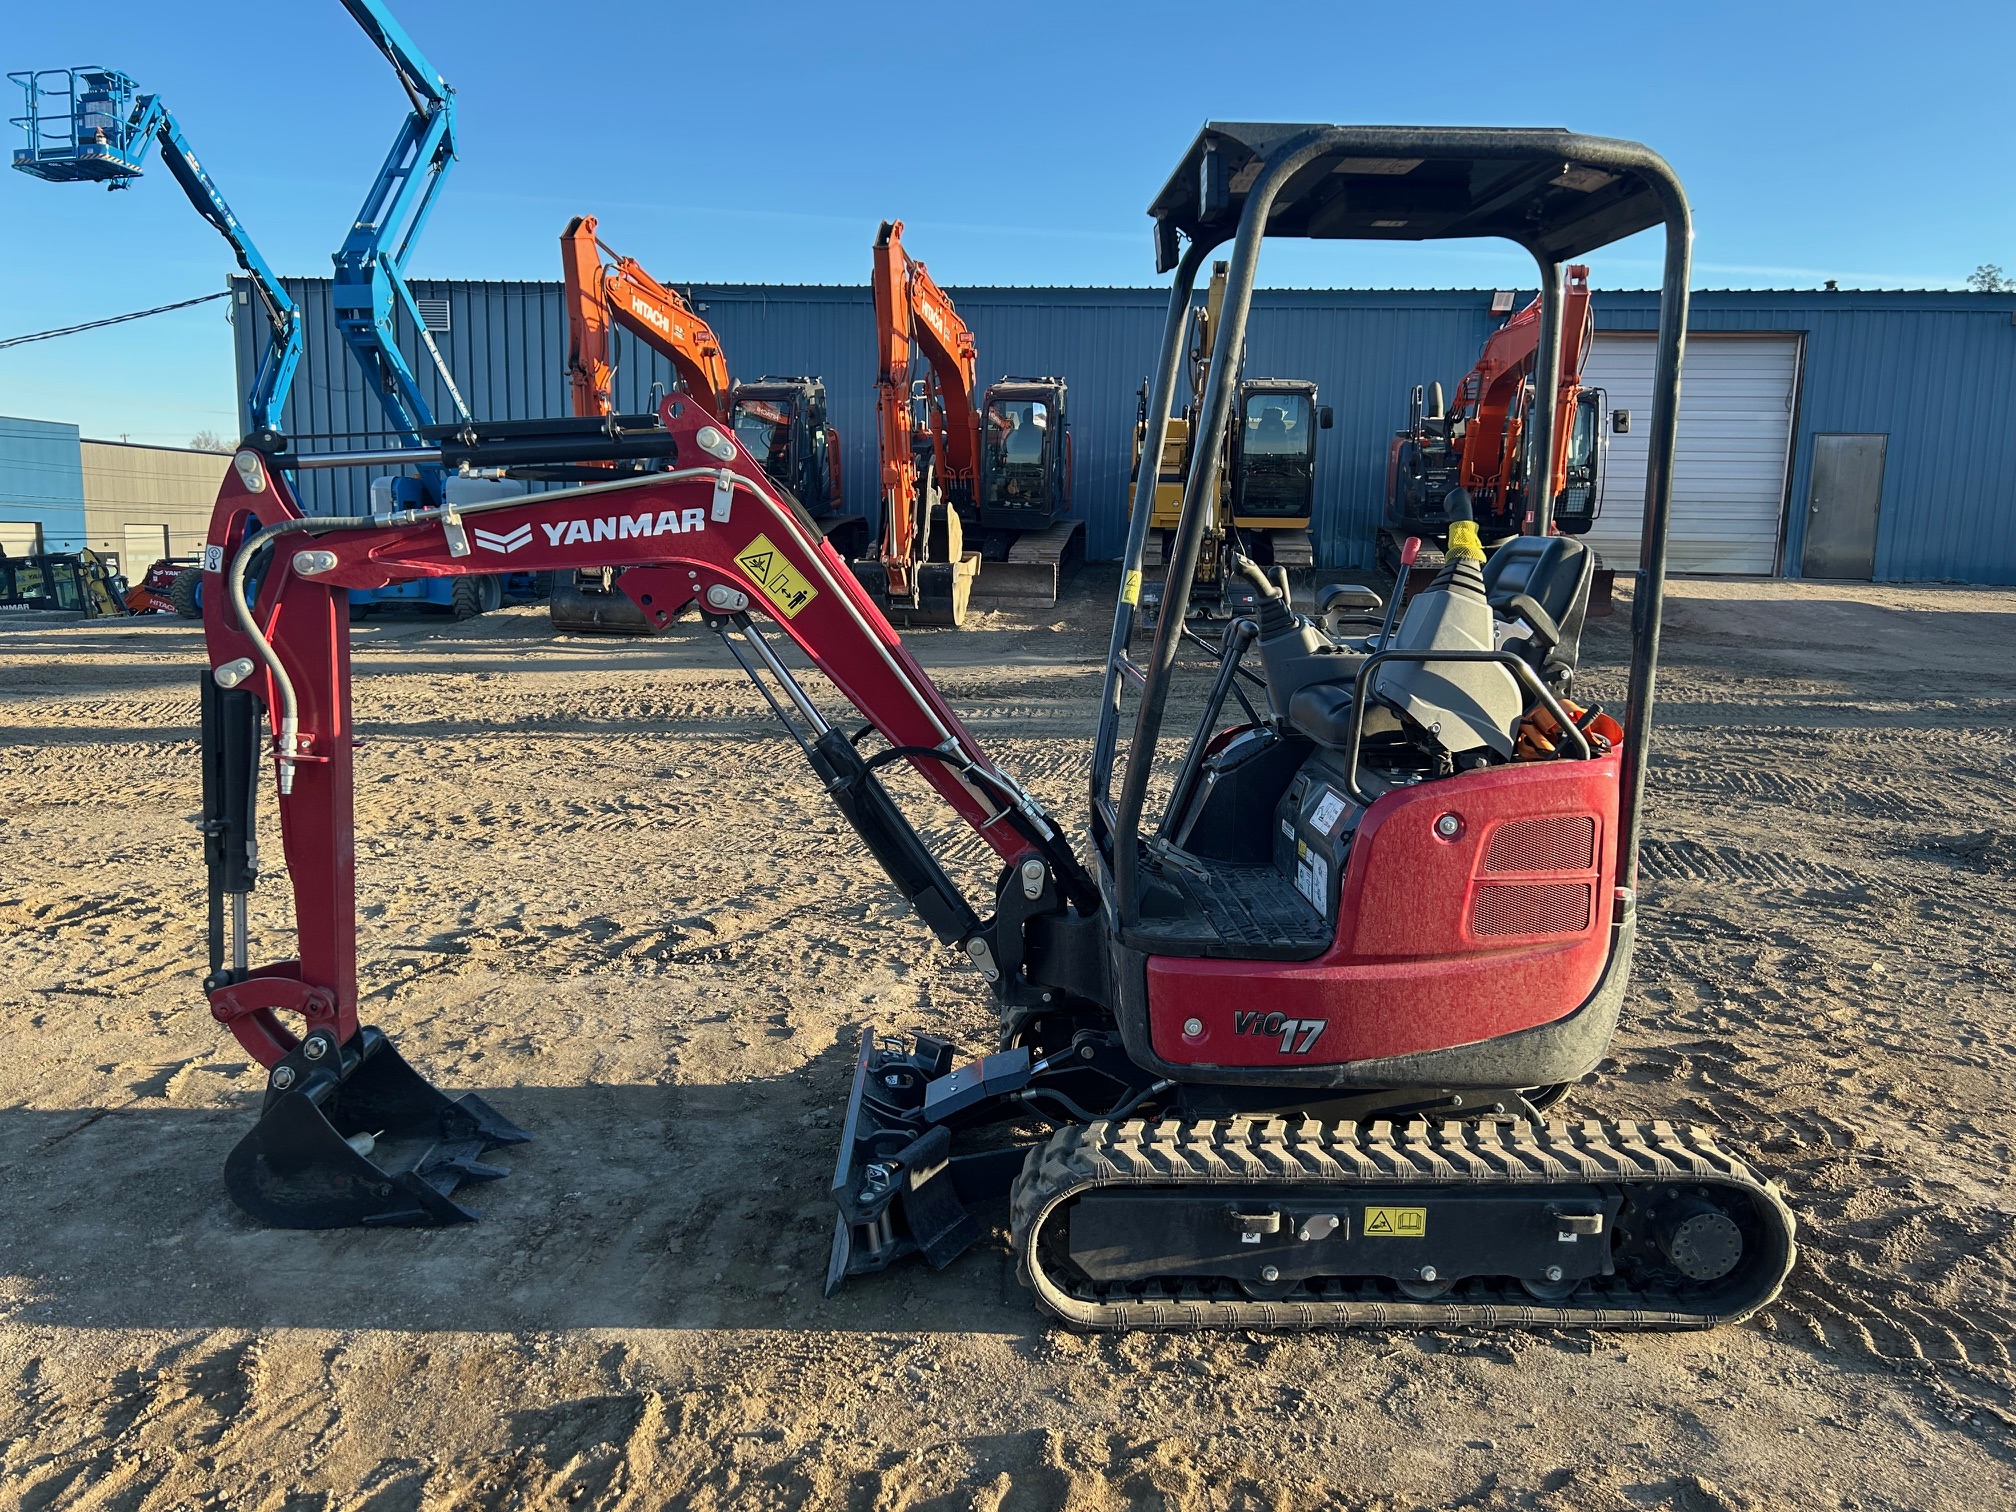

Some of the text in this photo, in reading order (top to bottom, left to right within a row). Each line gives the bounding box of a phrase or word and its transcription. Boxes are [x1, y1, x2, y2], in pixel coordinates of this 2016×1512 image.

[632, 295, 669, 332] HITACHI
[922, 299, 943, 334] HITACHI
[541, 508, 705, 546] YANMAR
[150, 599, 178, 612] HITAC
